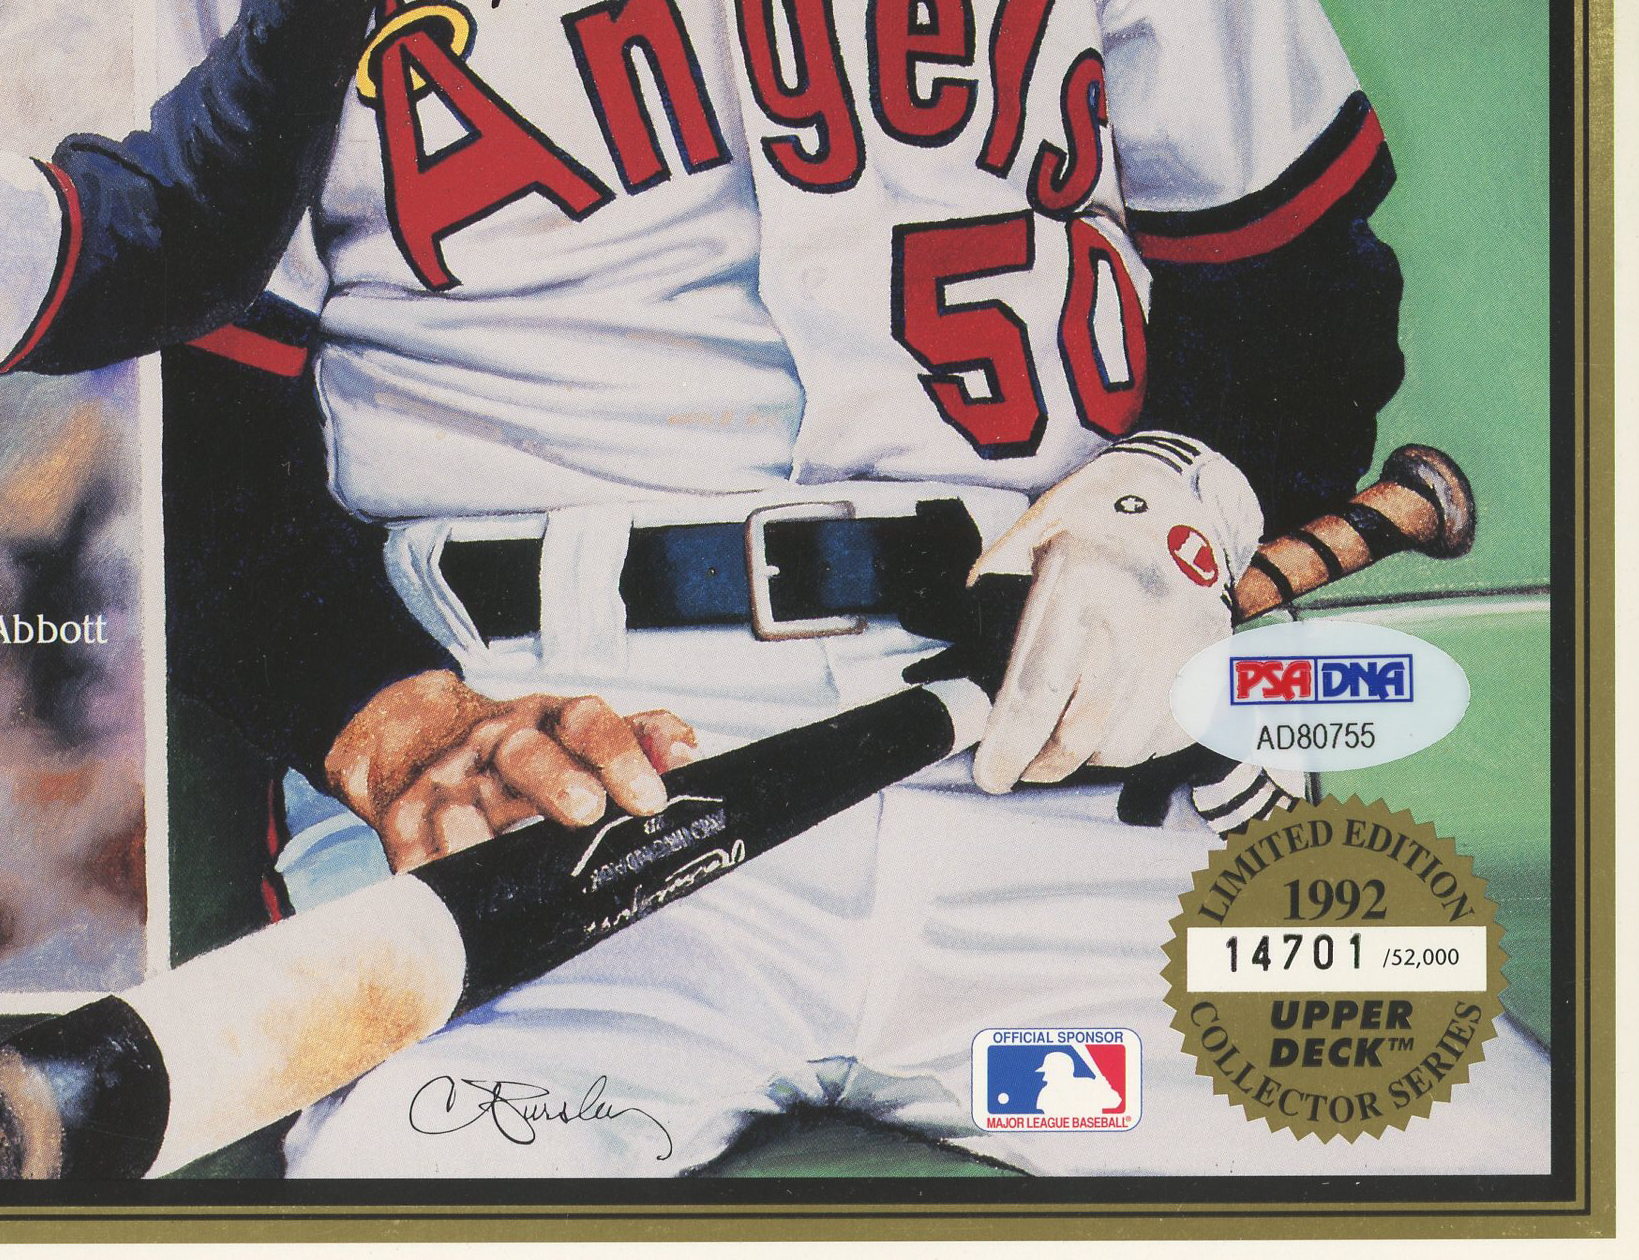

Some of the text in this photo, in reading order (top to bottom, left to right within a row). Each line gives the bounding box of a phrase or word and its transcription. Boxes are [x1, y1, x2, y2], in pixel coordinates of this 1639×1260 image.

[890, 209, 1150, 461] 50
[1235, 657, 1406, 701] PSA DNA
[1256, 722, 1376, 751] AD80755
[1198, 818, 1475, 925] LIMITED EDITION
[1283, 878, 1388, 921] 1992
[1226, 932, 1459, 972] 14701 /52,000
[1270, 1000, 1414, 1030] UPPER
[993, 1031, 1124, 1043] OFFICIAL SPONSOR
[1190, 1000, 1482, 1124] COLLECTOR SERIES
[986, 1117, 1024, 1129] MAJOR
[1027, 1117, 1070, 1129] LEAGUE
